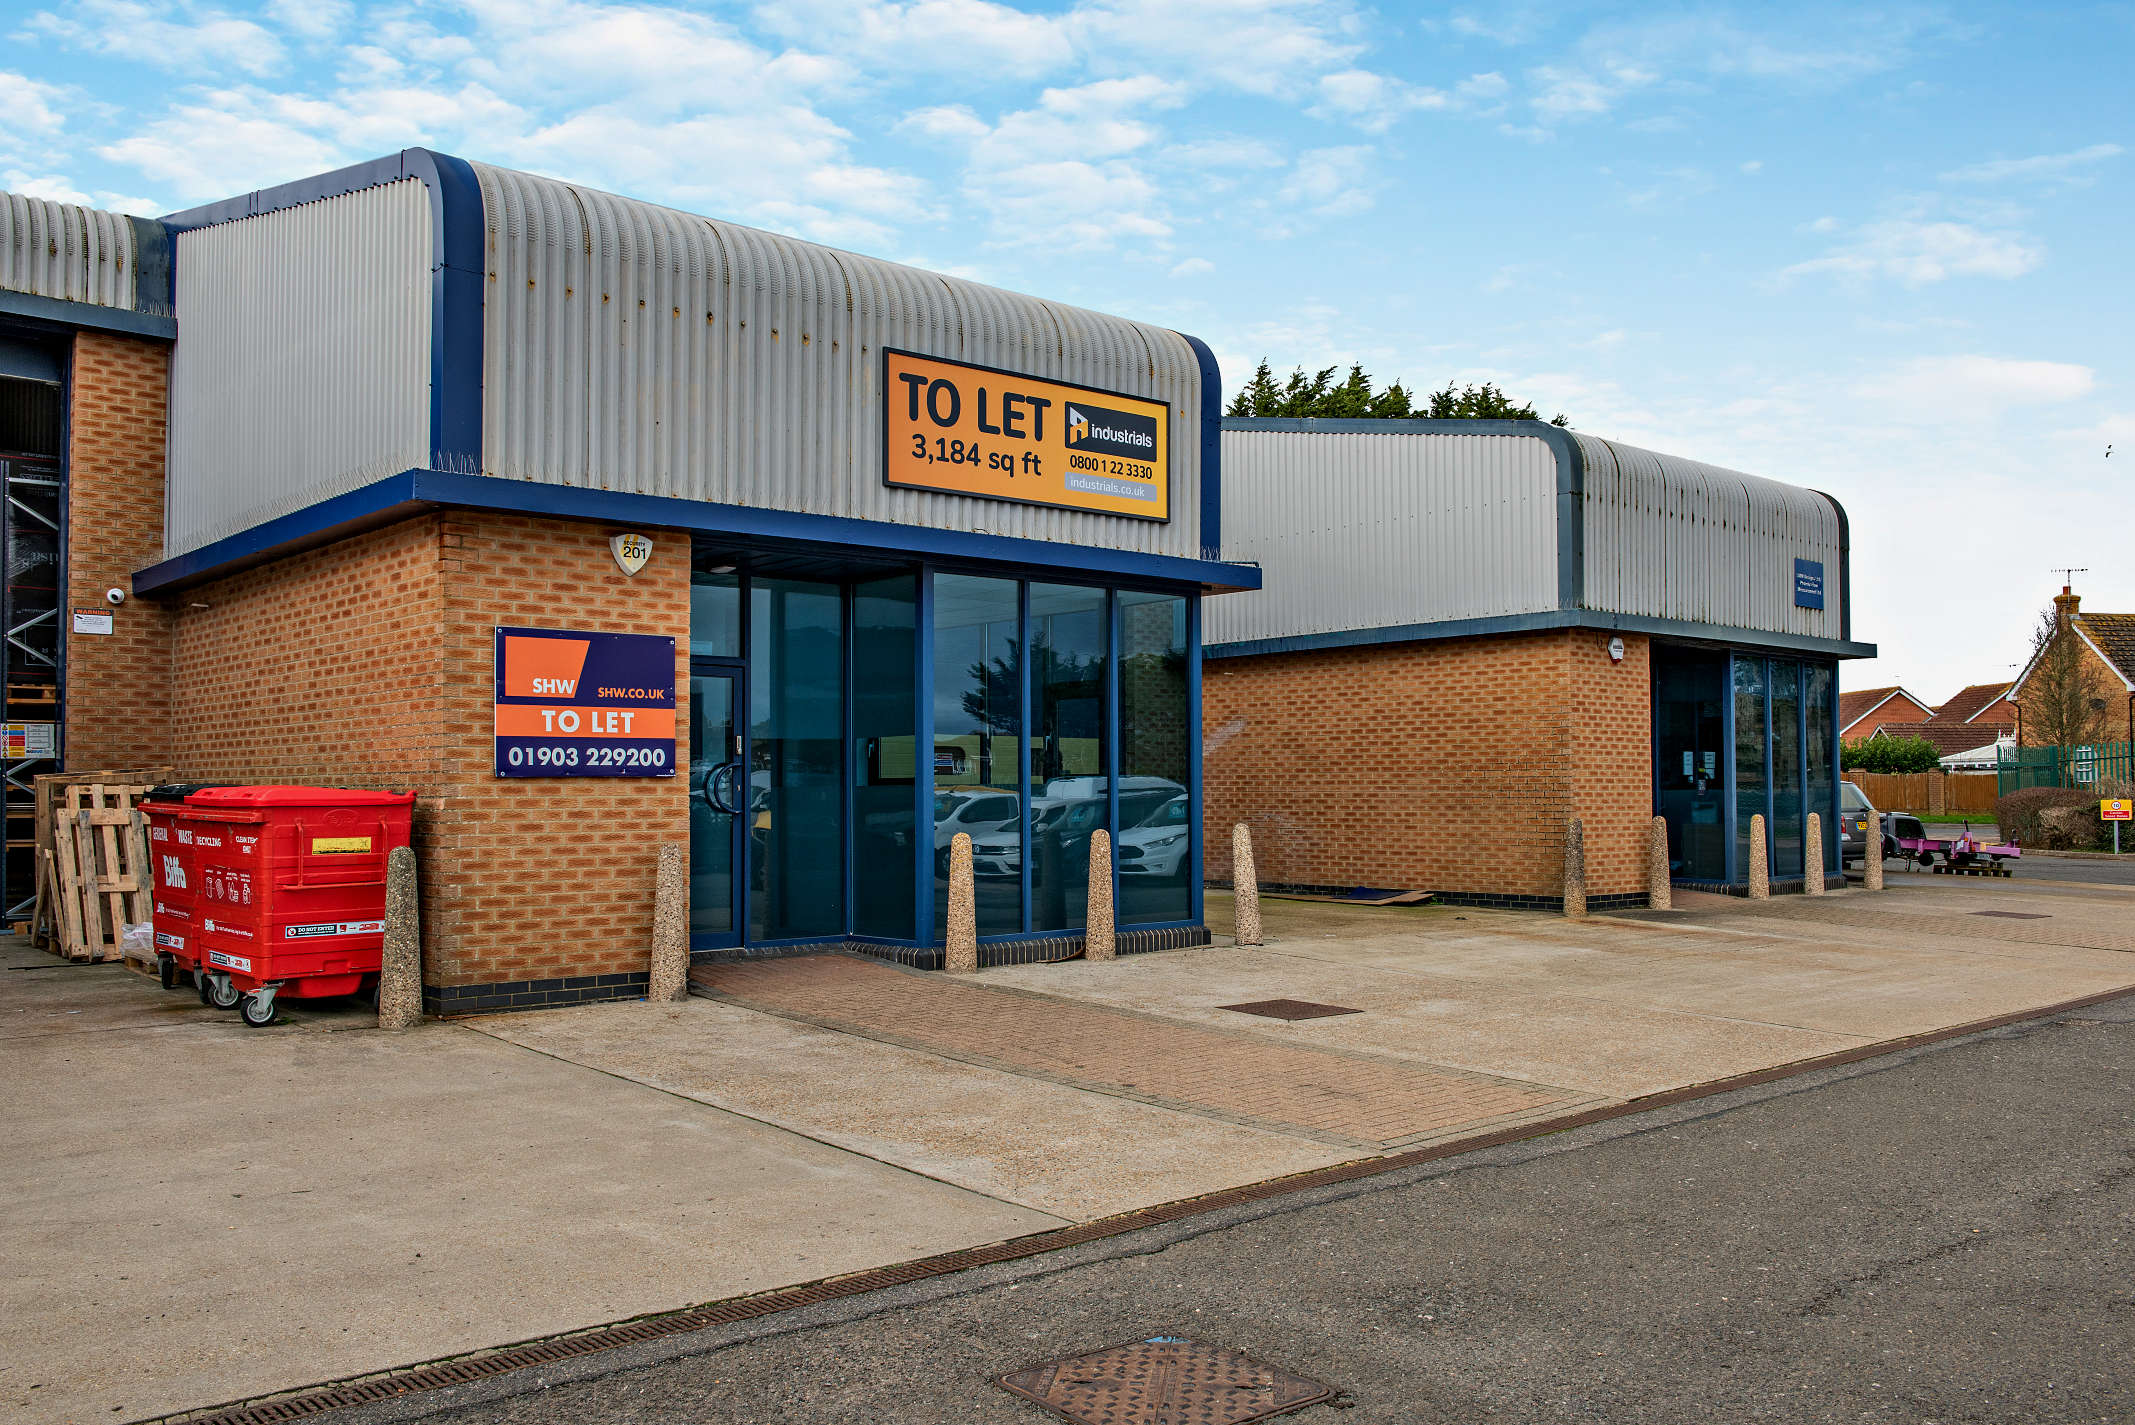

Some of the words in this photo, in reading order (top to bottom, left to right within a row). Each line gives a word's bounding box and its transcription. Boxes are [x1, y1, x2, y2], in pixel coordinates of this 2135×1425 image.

[899, 372, 961, 428] TO
[977, 387, 1051, 442] LET
[1091, 423, 1153, 448] industrials
[911, 433, 981, 467] 3,184
[988, 452, 1014, 478] sq
[1021, 451, 1042, 476] ft
[1069, 454, 1099, 472] 0800
[1101, 459, 1107, 473] 1
[1110, 461, 1124, 475] 22
[1126, 463, 1153, 480] 3330
[1070, 475, 1145, 497] industrials.co.uk
[623, 545, 646, 560] 201
[532, 677, 576, 694] SHW
[597, 687, 665, 700] SHW.CO.UK
[541, 710, 581, 733] TO
[591, 711, 635, 734] LET
[507, 746, 579, 767] 01903
[585, 747, 666, 767] 229200
[177, 829, 193, 845] WASTE
[163, 854, 187, 889] Biffa
